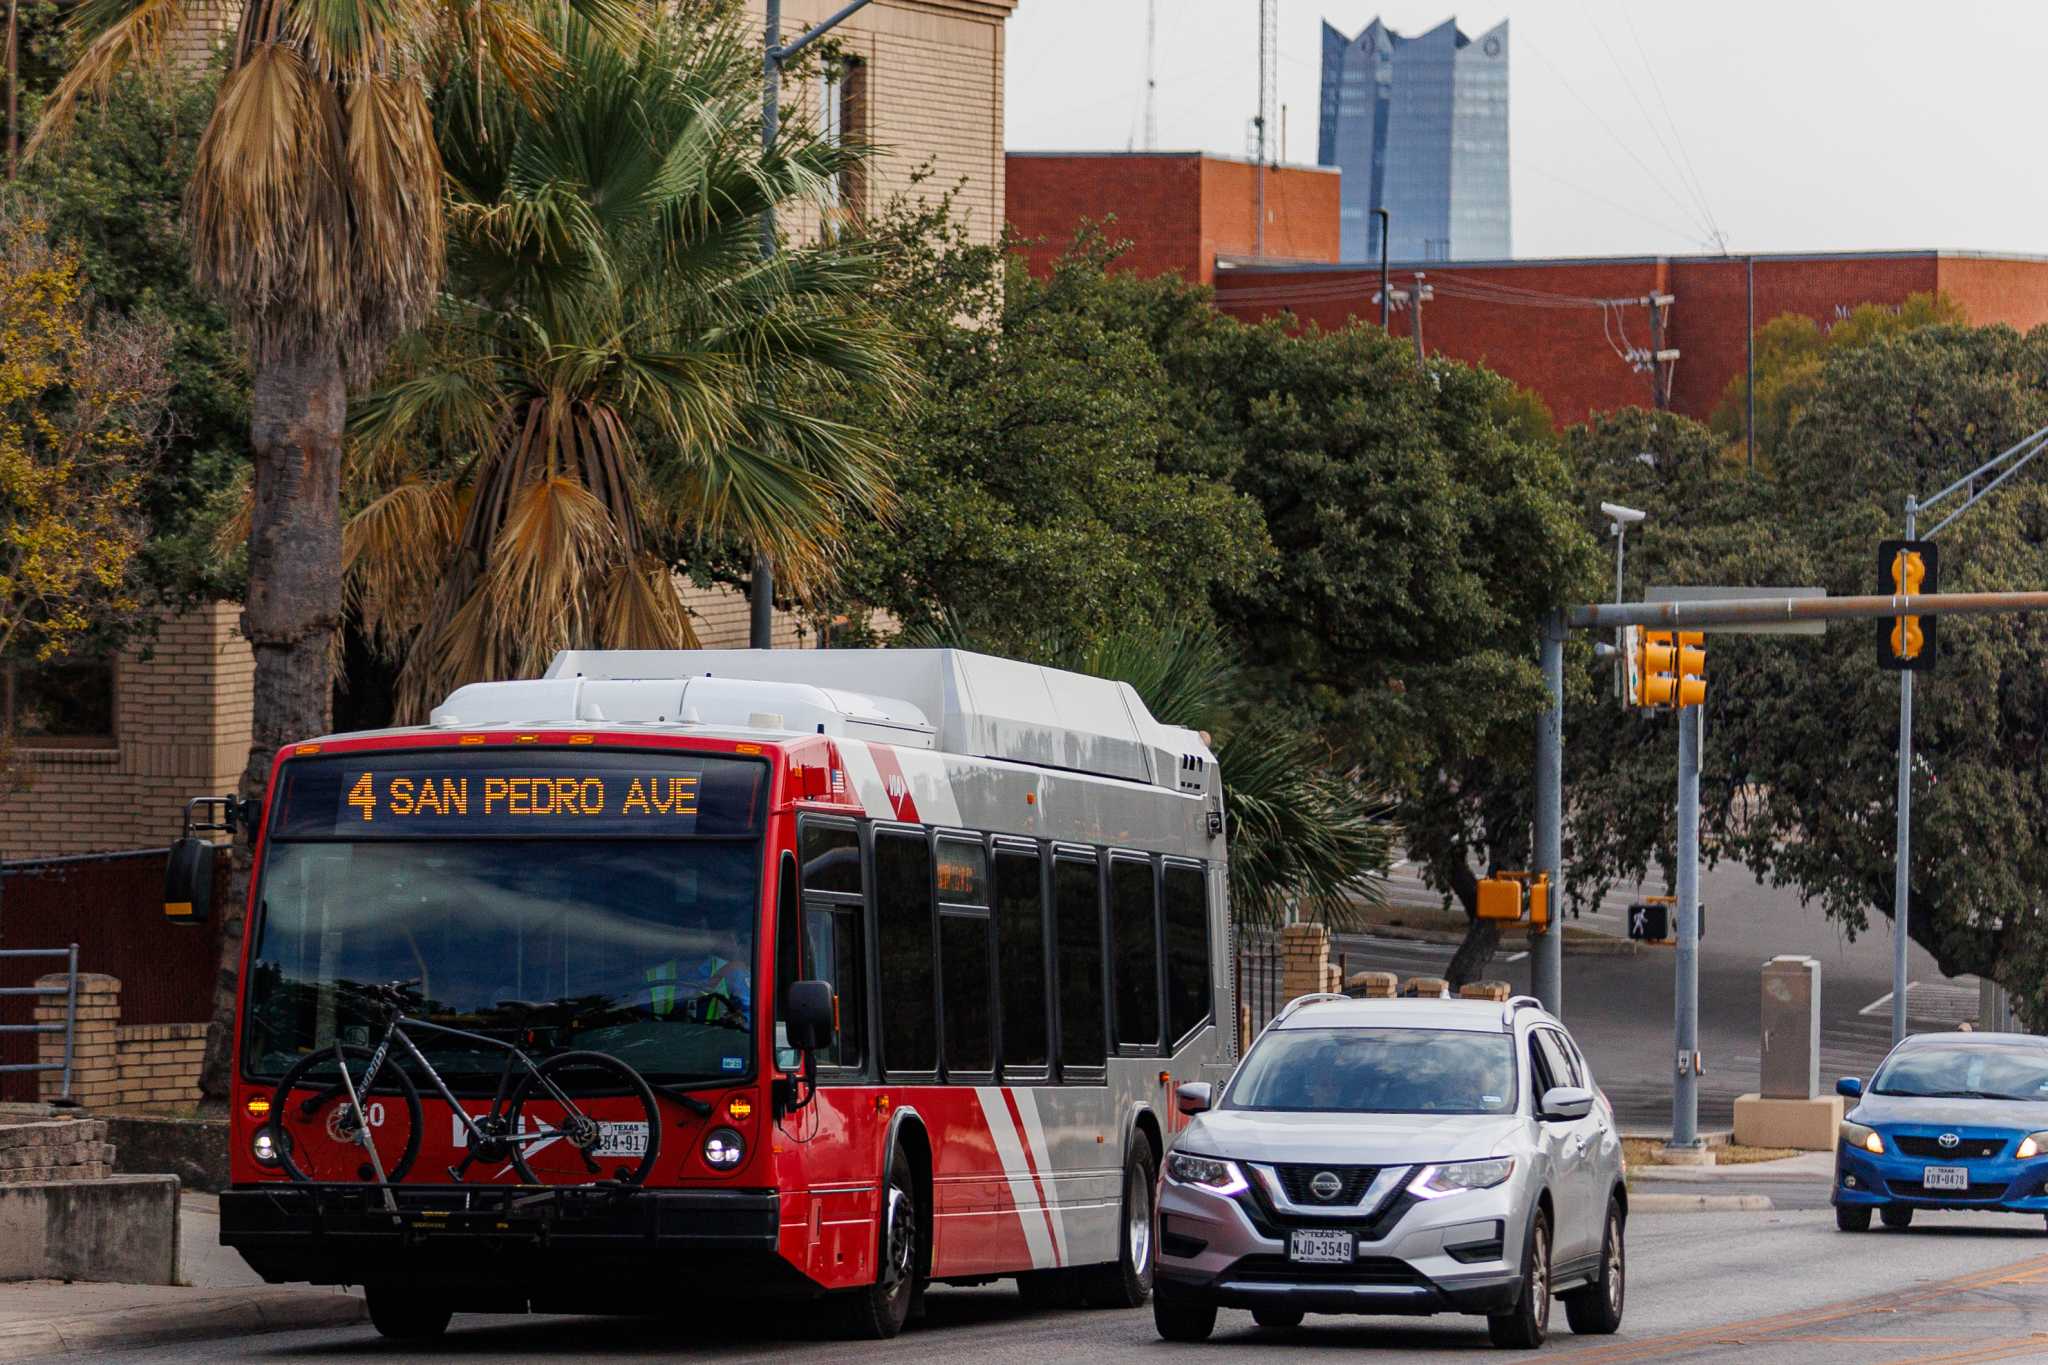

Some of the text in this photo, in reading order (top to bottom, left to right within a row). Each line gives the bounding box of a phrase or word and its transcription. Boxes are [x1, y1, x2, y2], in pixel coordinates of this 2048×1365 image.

[348, 772, 698, 821] 4 SAN PEDRO AVE
